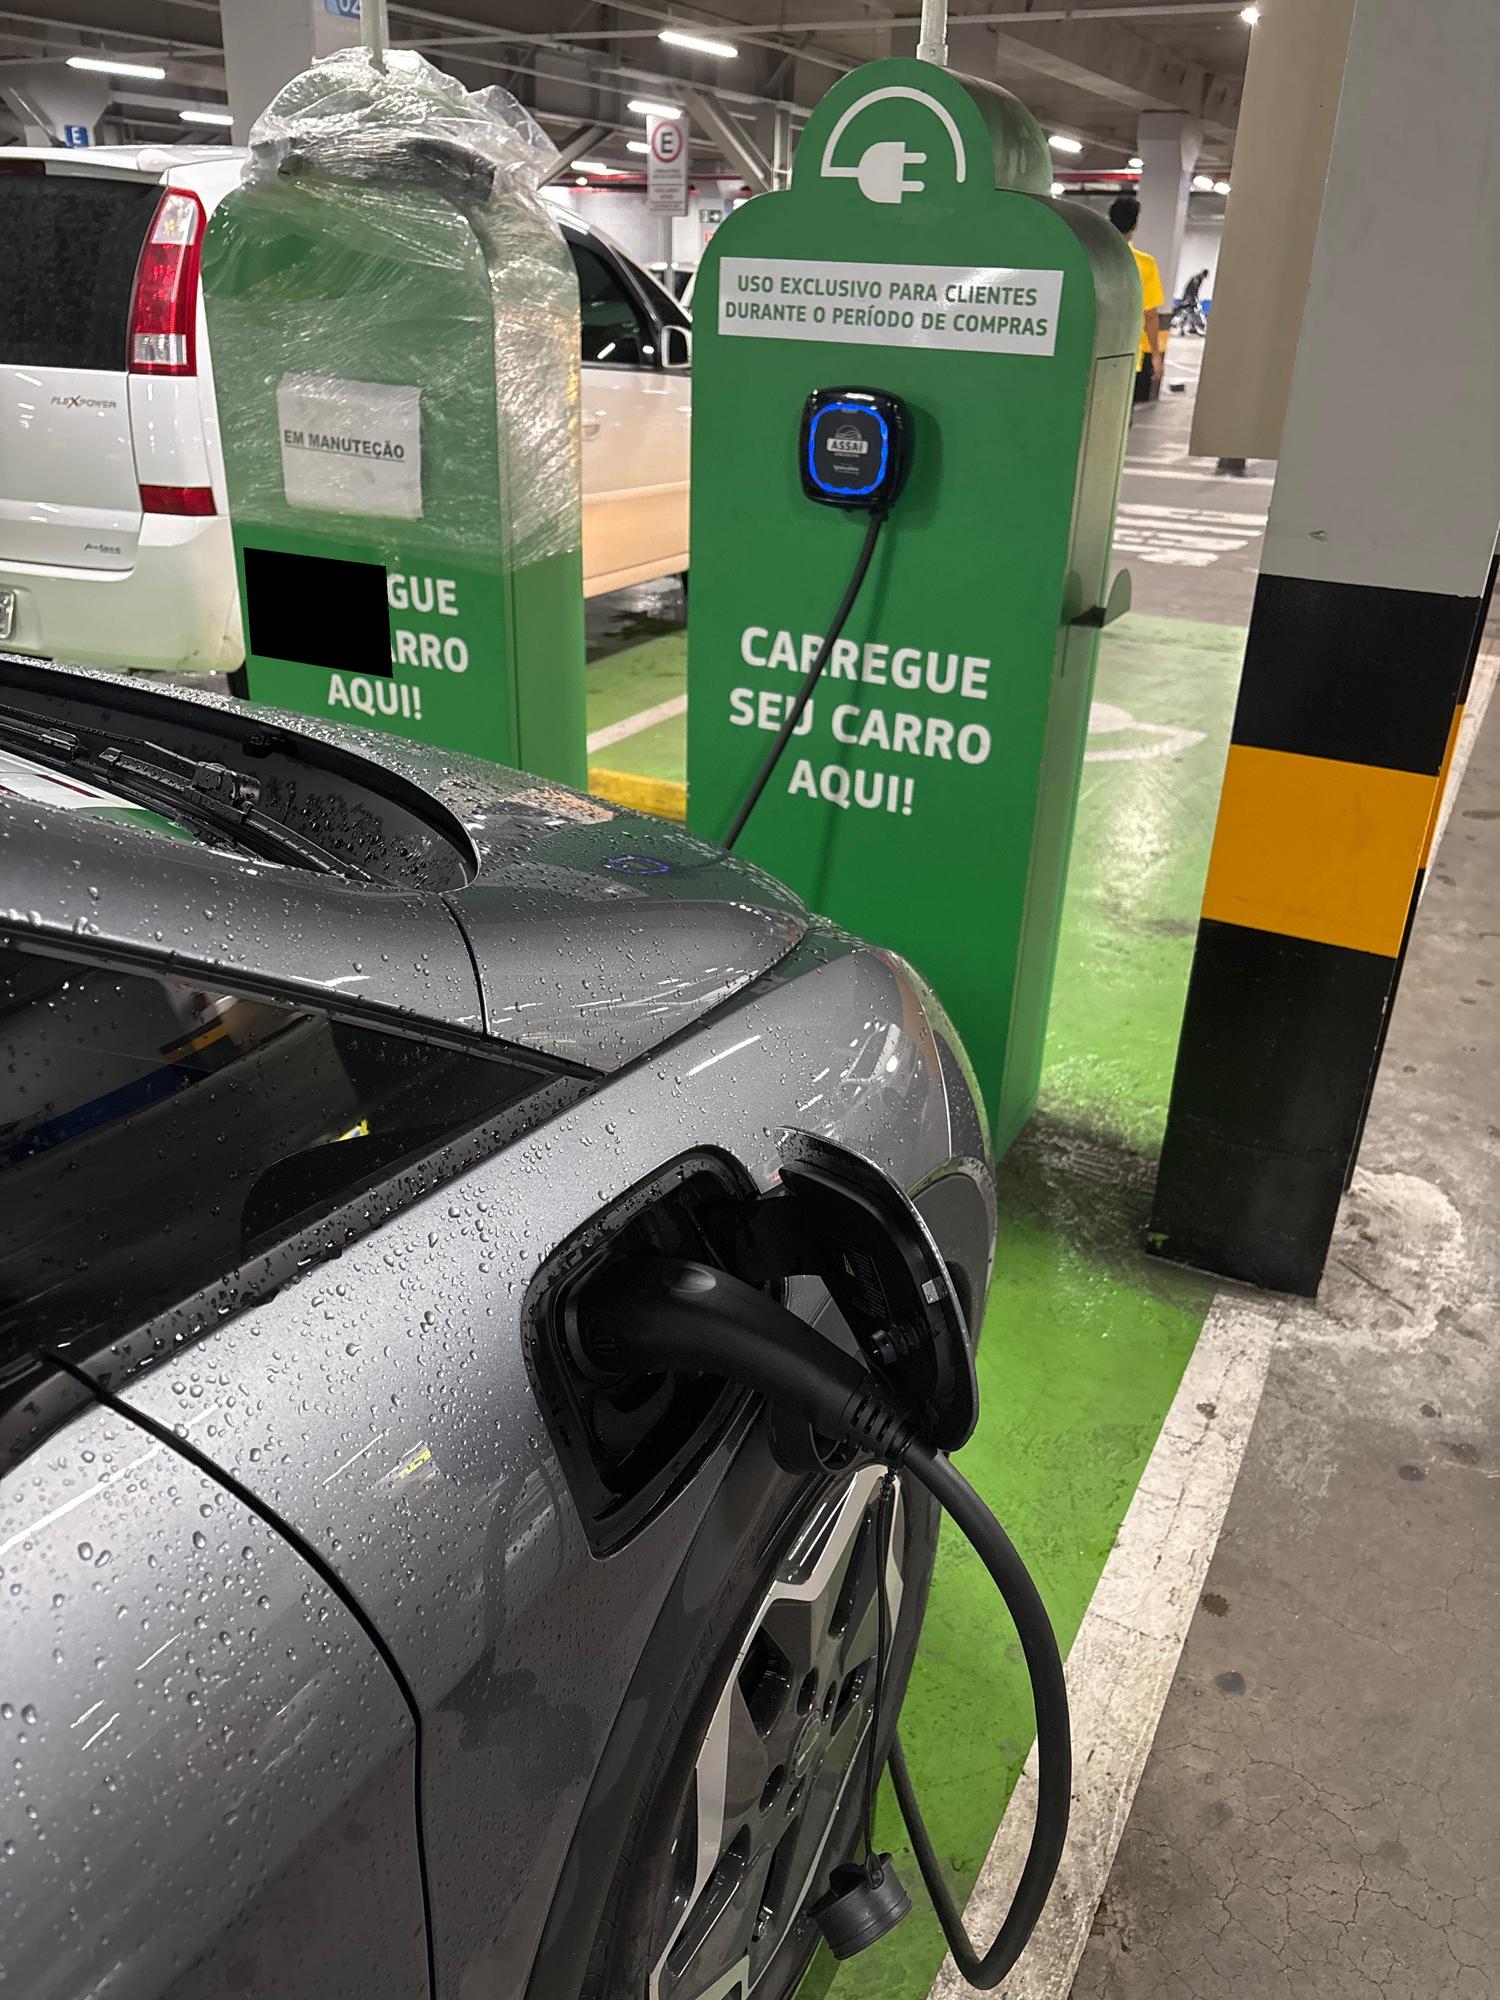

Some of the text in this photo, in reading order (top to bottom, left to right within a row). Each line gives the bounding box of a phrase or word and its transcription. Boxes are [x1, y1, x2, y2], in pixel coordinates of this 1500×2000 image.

[70, 126, 81, 145] E
[661, 132, 673, 153] E
[738, 275, 1037, 306] USO EXCLUSIVO PARA CLIENTES
[725, 301, 1047, 336] DURANTE O PERÍODO DE COMPRAS
[284, 430, 404, 459] EM MANUTEÇÃO
[391, 629, 468, 673] RRO
[740, 626, 991, 700] CARREGUE
[327, 673, 422, 720] AQUI!
[729, 687, 991, 765] SEU CARRO
[787, 759, 915, 816] AQUI!
